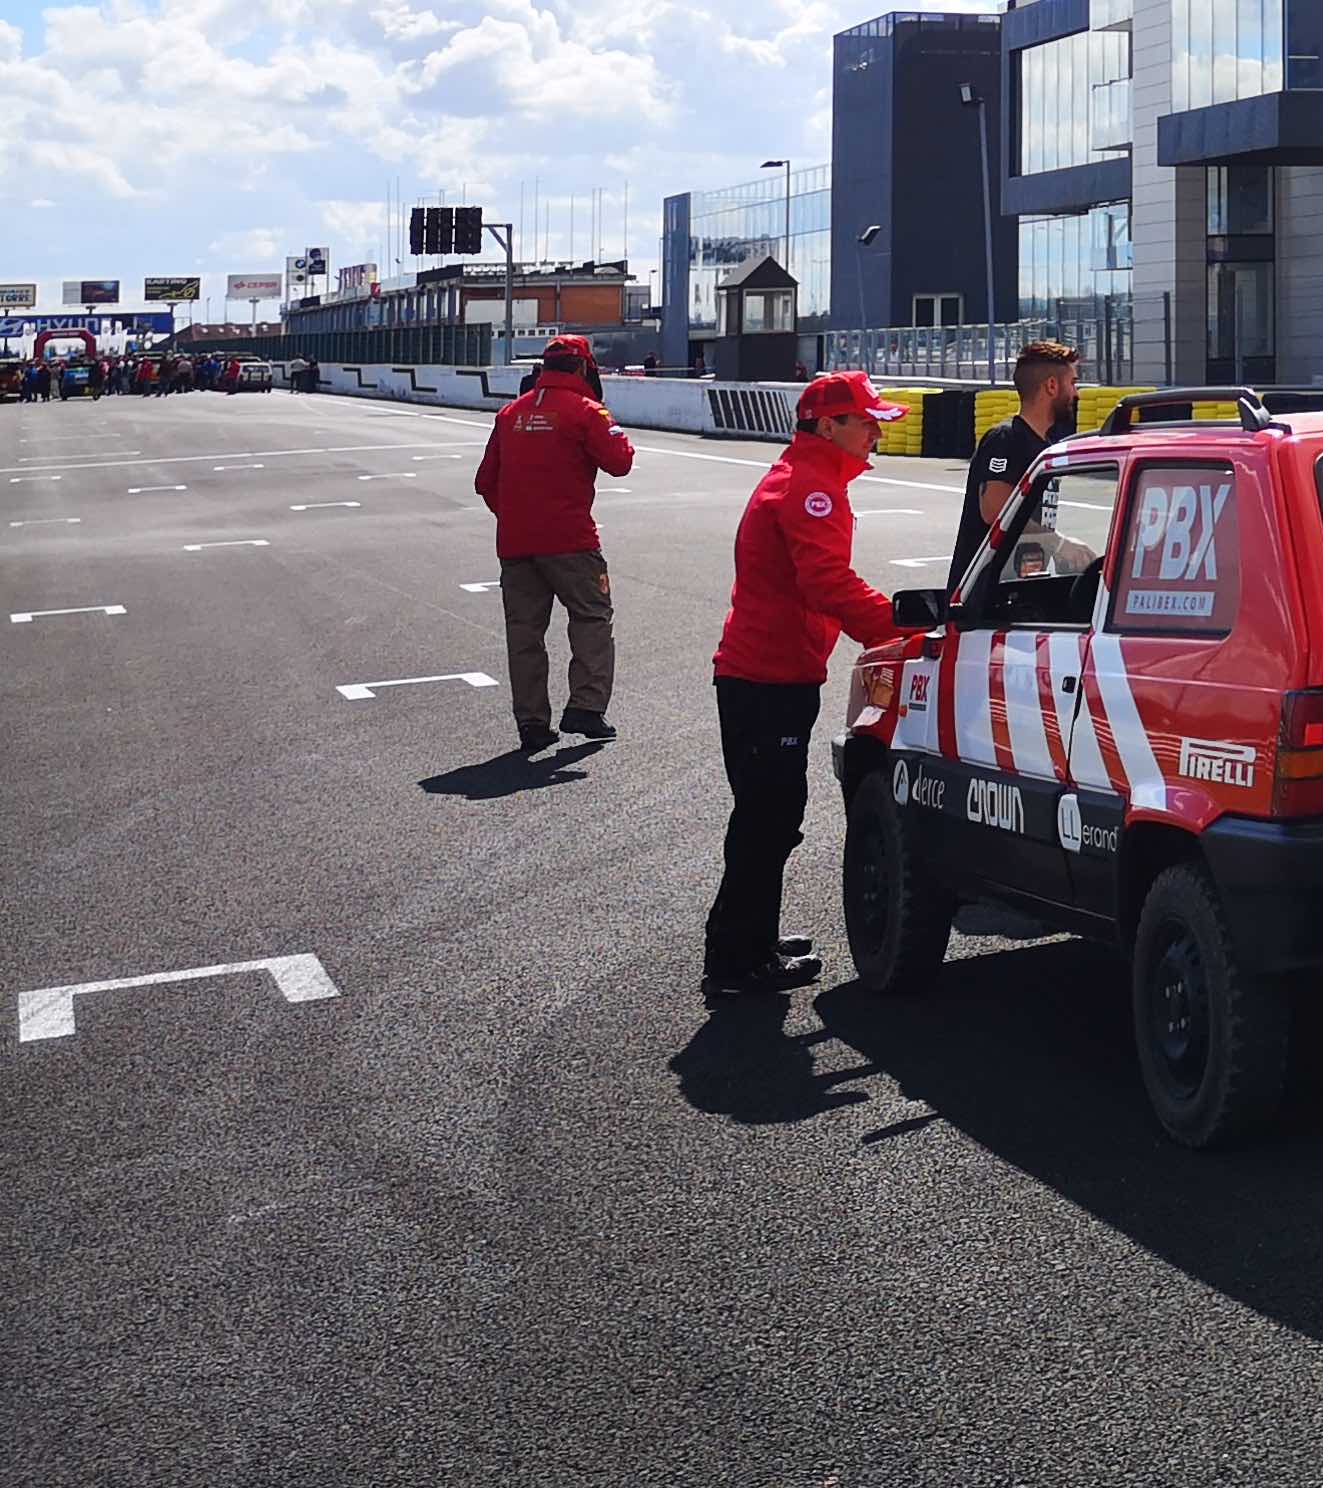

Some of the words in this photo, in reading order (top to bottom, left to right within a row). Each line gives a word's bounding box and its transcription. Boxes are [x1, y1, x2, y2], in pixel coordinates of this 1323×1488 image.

[1131, 484, 1233, 581] PBX
[909, 674, 931, 703] PBX
[780, 737, 799, 747] PBX
[1178, 736, 1256, 788] PIRELLI
[967, 778, 1025, 834] CROWN
